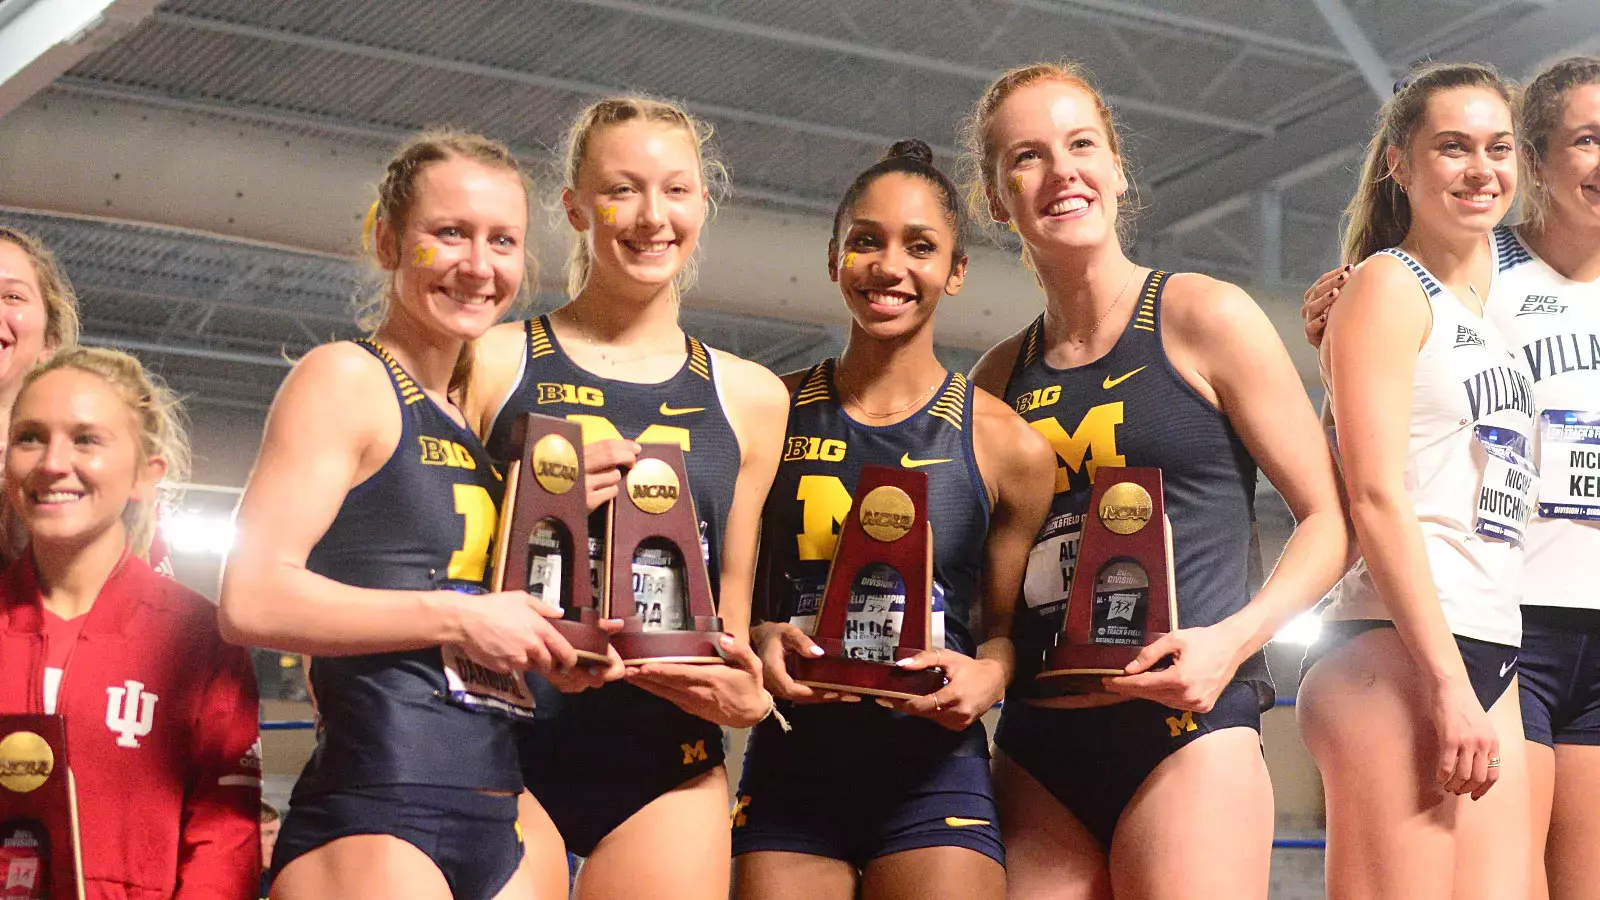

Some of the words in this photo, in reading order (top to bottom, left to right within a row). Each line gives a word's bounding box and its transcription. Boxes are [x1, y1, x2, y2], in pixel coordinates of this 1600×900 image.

[1519, 303, 1569, 314] EAST
[1524, 294, 1559, 304] BIG
[1455, 334, 1486, 347] EAST
[1457, 324, 1478, 337] BIG
[1522, 333, 1600, 384] VILLA
[1462, 366, 1535, 421] VILLANO
[1028, 400, 1126, 495] M
[1569, 450, 1600, 470] MC
[537, 459, 577, 482] NCAA
[633, 484, 679, 500] NCAA
[1063, 514, 1080, 526] FIELD
[1102, 504, 1150, 522] NCAA
[1059, 538, 1080, 562] AL
[1166, 711, 1198, 737] M
[680, 739, 708, 765] M
